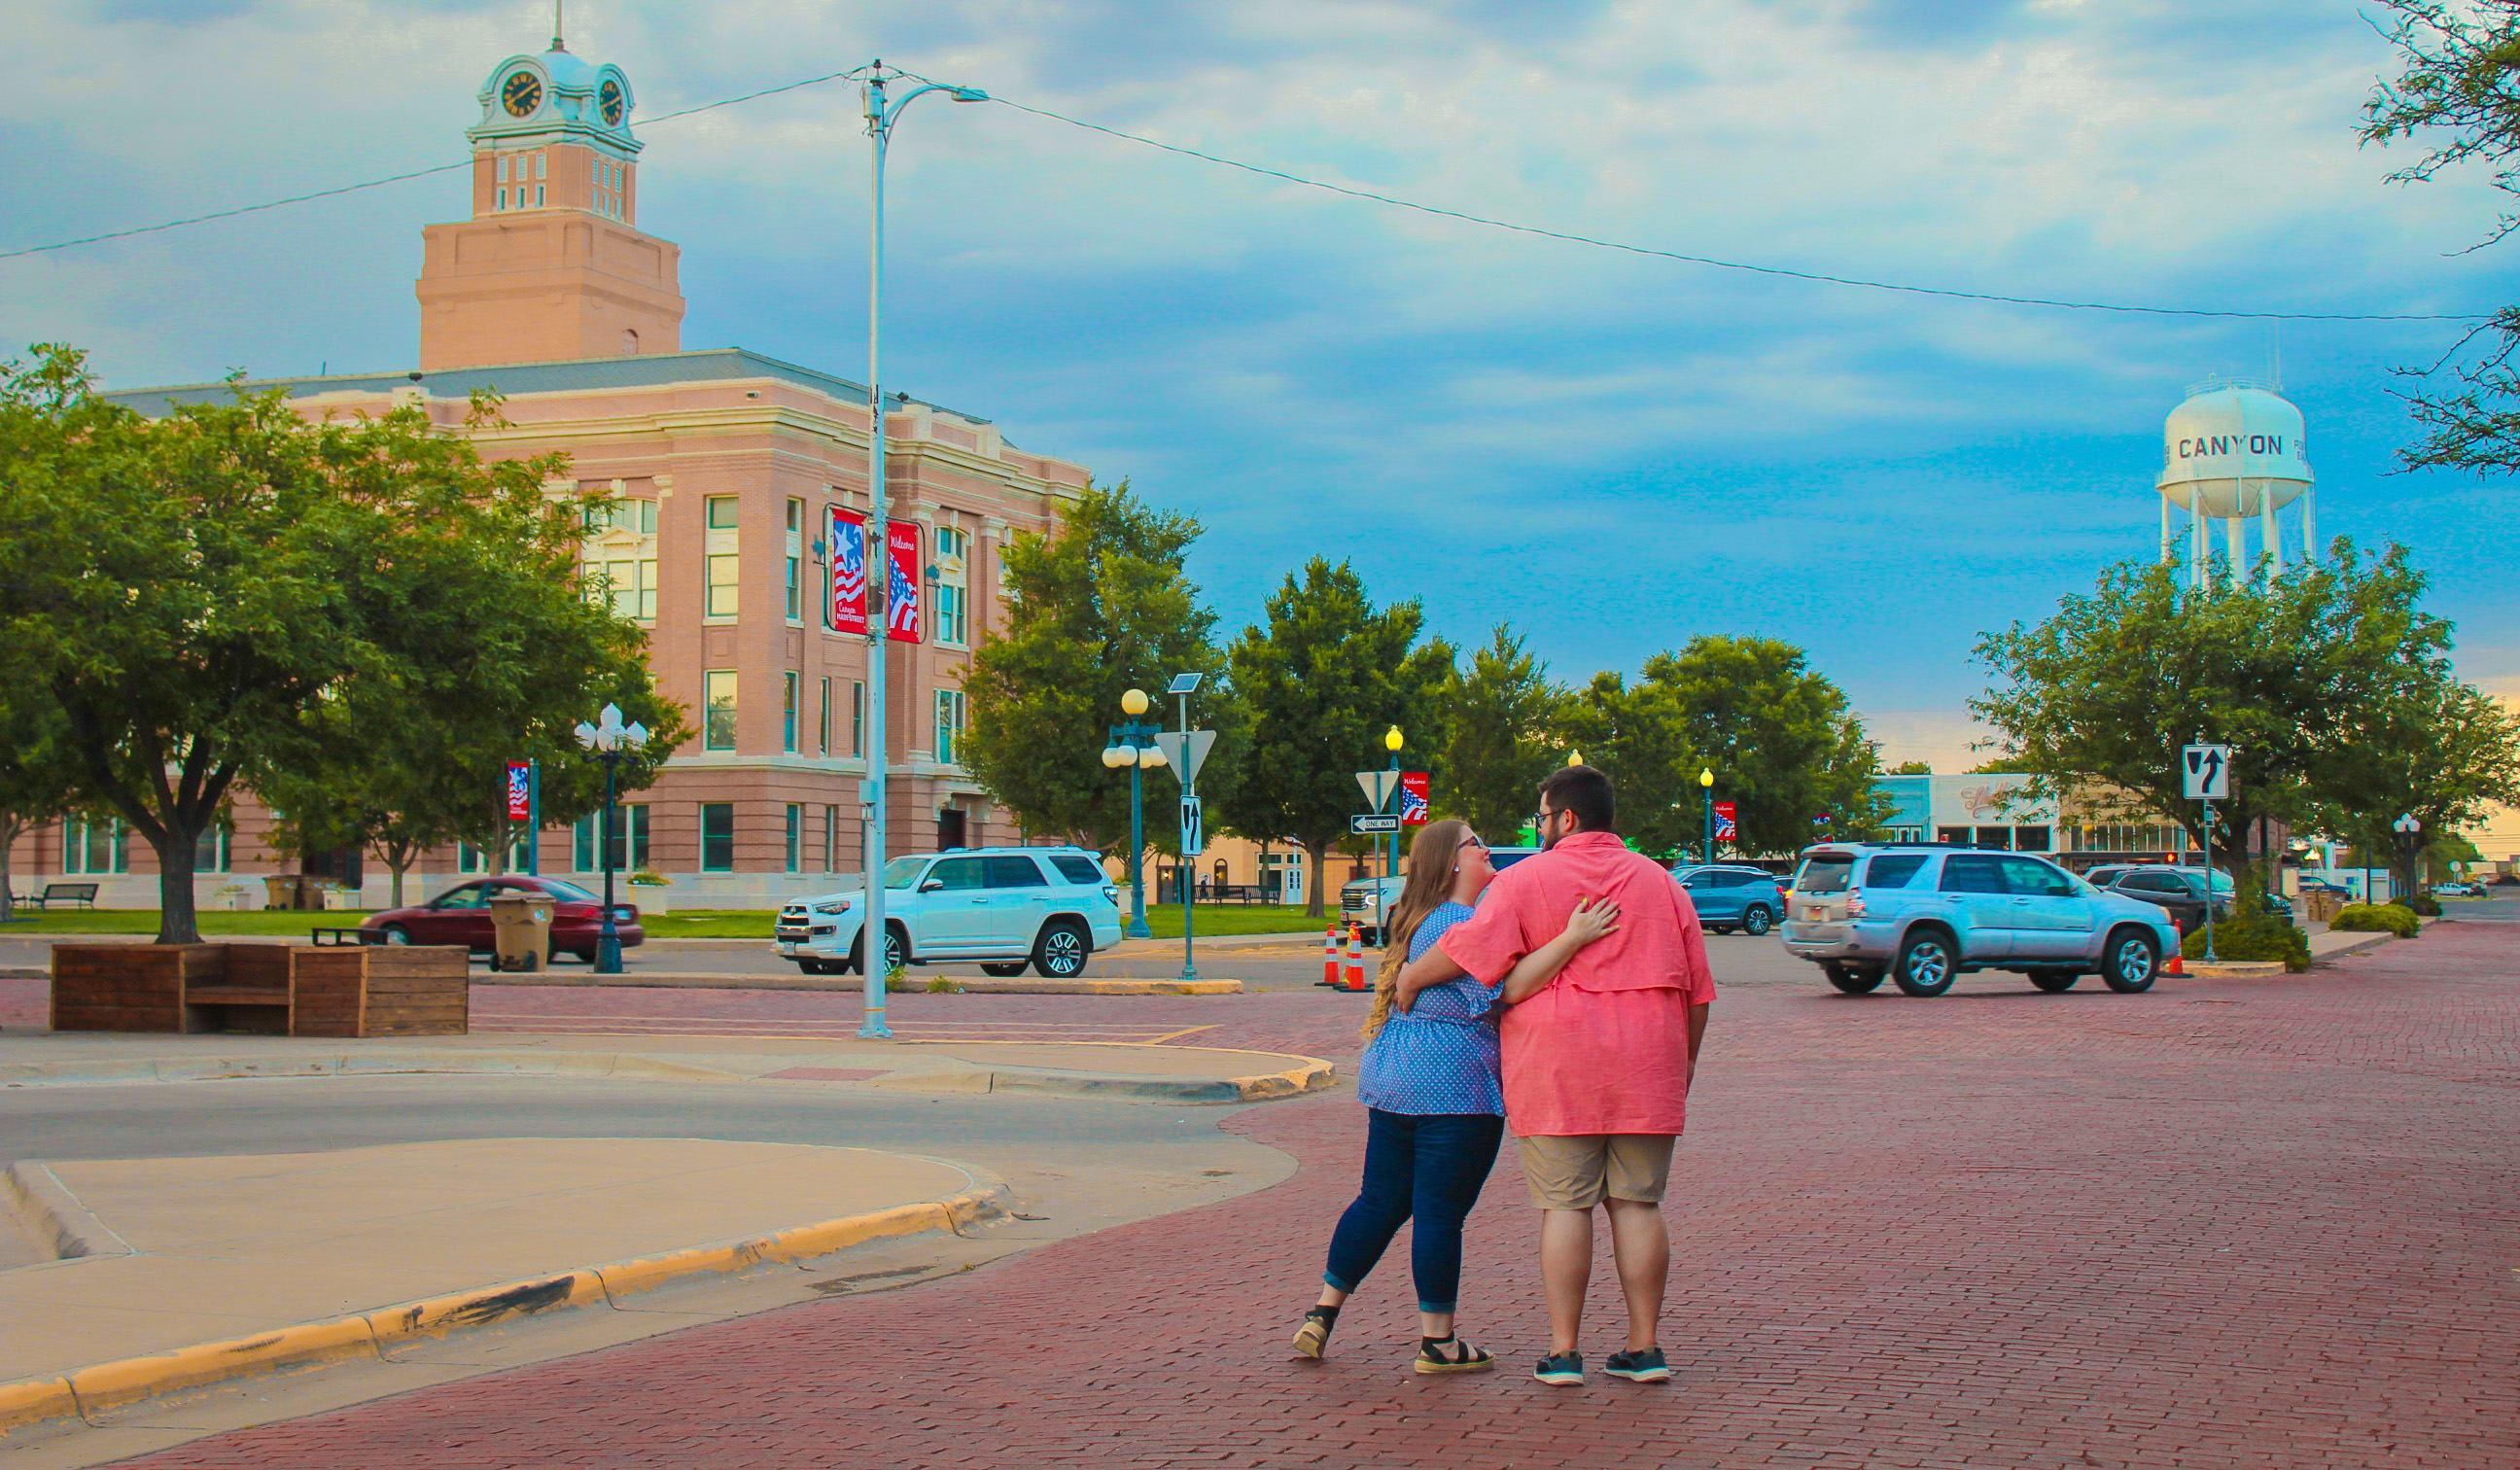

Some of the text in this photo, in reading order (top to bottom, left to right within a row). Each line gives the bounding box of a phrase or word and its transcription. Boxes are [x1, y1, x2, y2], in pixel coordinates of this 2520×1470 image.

[2179, 435, 2282, 459] CANYON
[890, 535, 915, 551] Welcome
[838, 602, 857, 613] Canyon
